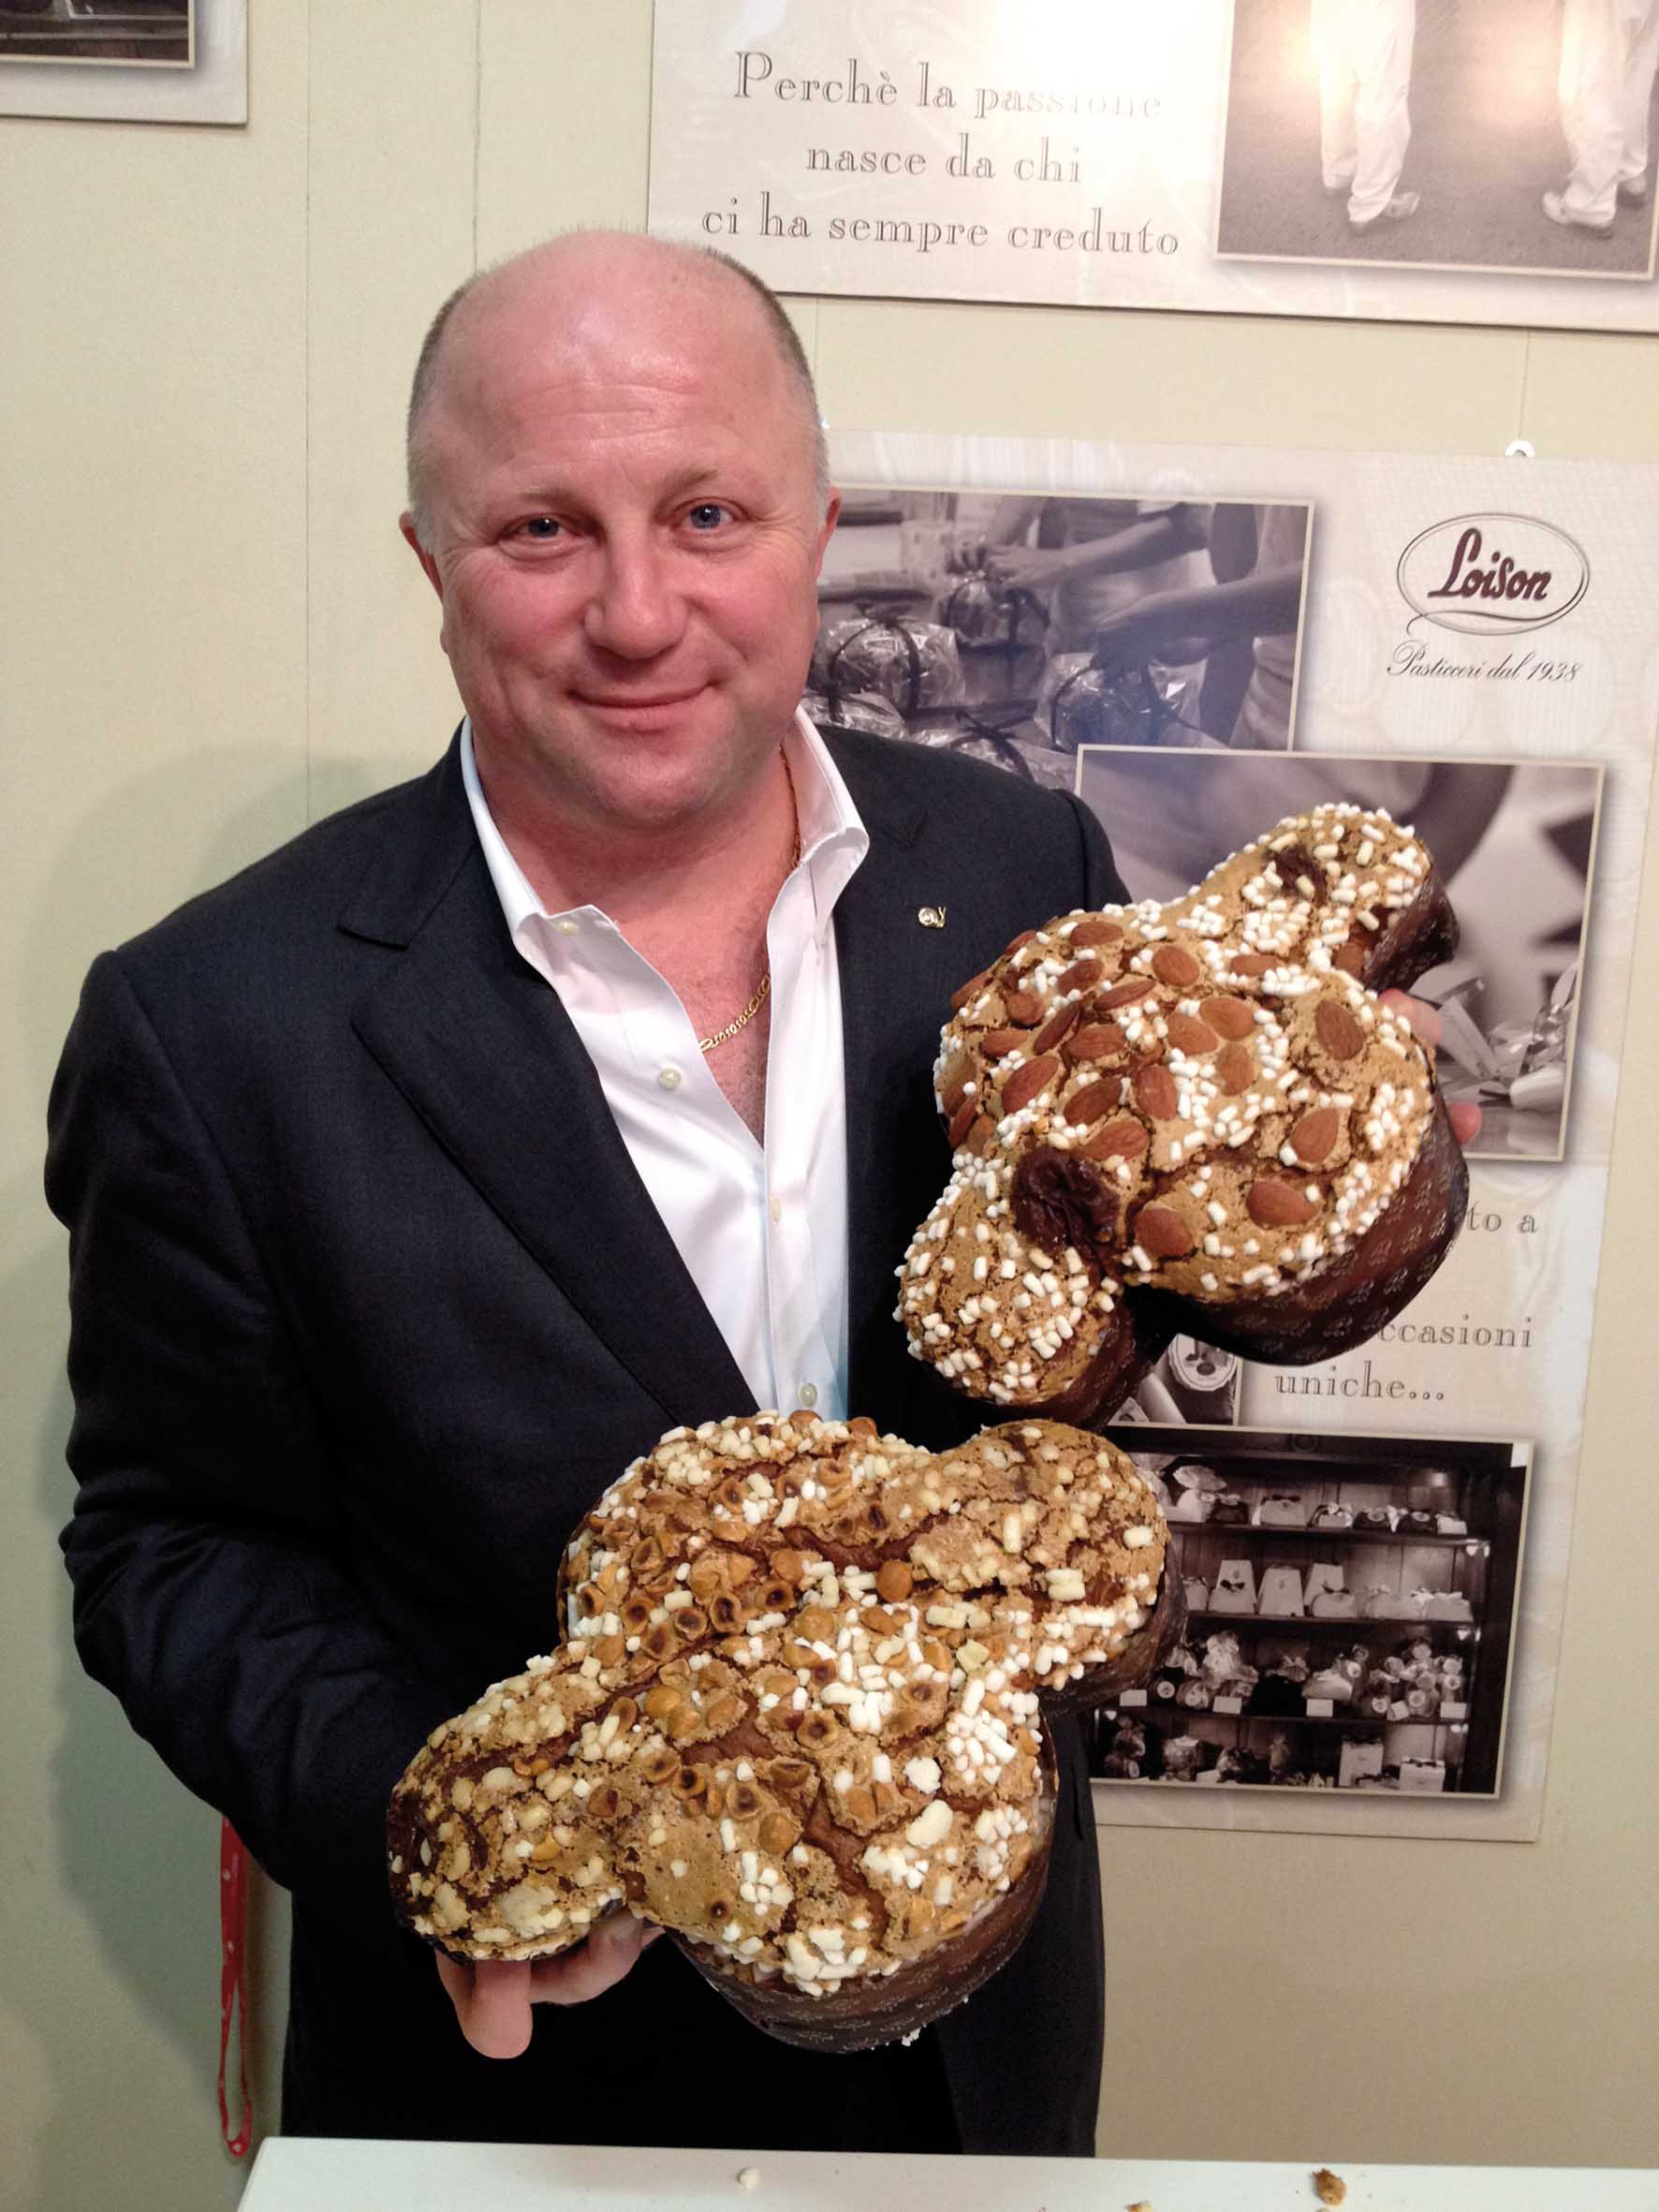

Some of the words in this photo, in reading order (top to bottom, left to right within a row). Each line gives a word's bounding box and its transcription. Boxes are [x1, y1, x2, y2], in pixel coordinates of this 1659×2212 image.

[734, 51, 899, 107] Perchè
[917, 62, 957, 109] la
[974, 87, 1162, 120] passione
[806, 147, 927, 175] nasce
[946, 133, 997, 180] da
[1014, 137, 1081, 183] chi
[701, 198, 739, 235] ci
[760, 192, 812, 239] ha
[828, 215, 990, 253] sempre
[1007, 208, 1180, 257] creduto
[1427, 527, 1551, 601] Loison
[1387, 640, 1487, 678] Pasticceri
[1486, 651, 1536, 680] dal
[1526, 659, 1581, 683] 1938
[1466, 1200, 1502, 1232] to
[1518, 1214, 1537, 1232] a
[1377, 1314, 1534, 1349] ccasioni
[1274, 1360, 1445, 1401] uniche...
